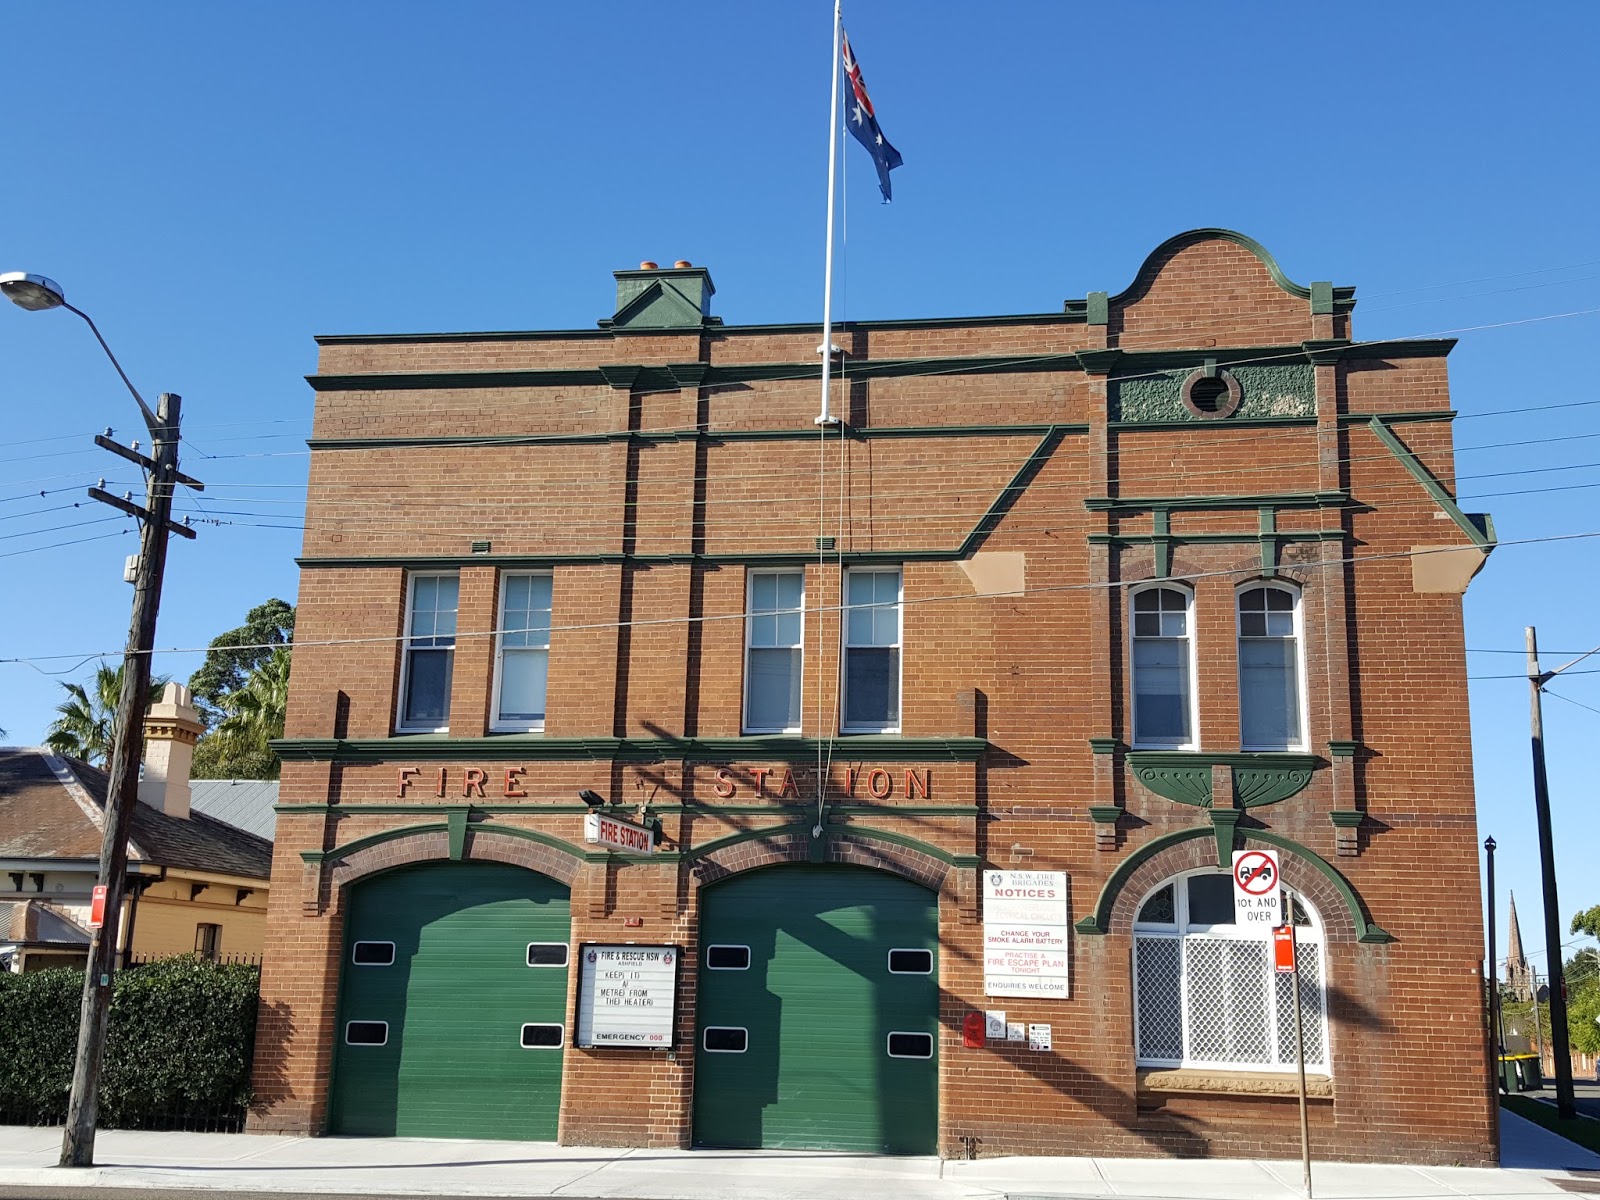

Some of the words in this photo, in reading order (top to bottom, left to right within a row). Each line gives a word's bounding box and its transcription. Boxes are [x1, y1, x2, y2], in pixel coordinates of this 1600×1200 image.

[397, 767, 522, 797] FIRE
[713, 768, 929, 798] STATION
[601, 820, 618, 843] FIRE
[621, 826, 649, 851] STATION
[995, 889, 1055, 898] NOTICES
[1237, 899, 1251, 908] 10t
[1257, 898, 1277, 908] AND
[1247, 911, 1271, 922] OVER
[601, 951, 614, 960] FIRE
[616, 952, 620, 960] &
[621, 952, 645, 961] RESCUE
[645, 952, 660, 961] NSW
[987, 958, 1005, 966] FIRE
[1008, 959, 1039, 967] ESCAPE
[1042, 960, 1064, 968] PLAN
[605, 971, 623, 979] KEEP
[1028, 983, 1065, 991] WELCOME
[629, 989, 648, 997] FROM
[606, 997, 618, 1005] THE
[624, 998, 652, 1006] HEATER
[596, 1033, 646, 1041] EMERGENCY
